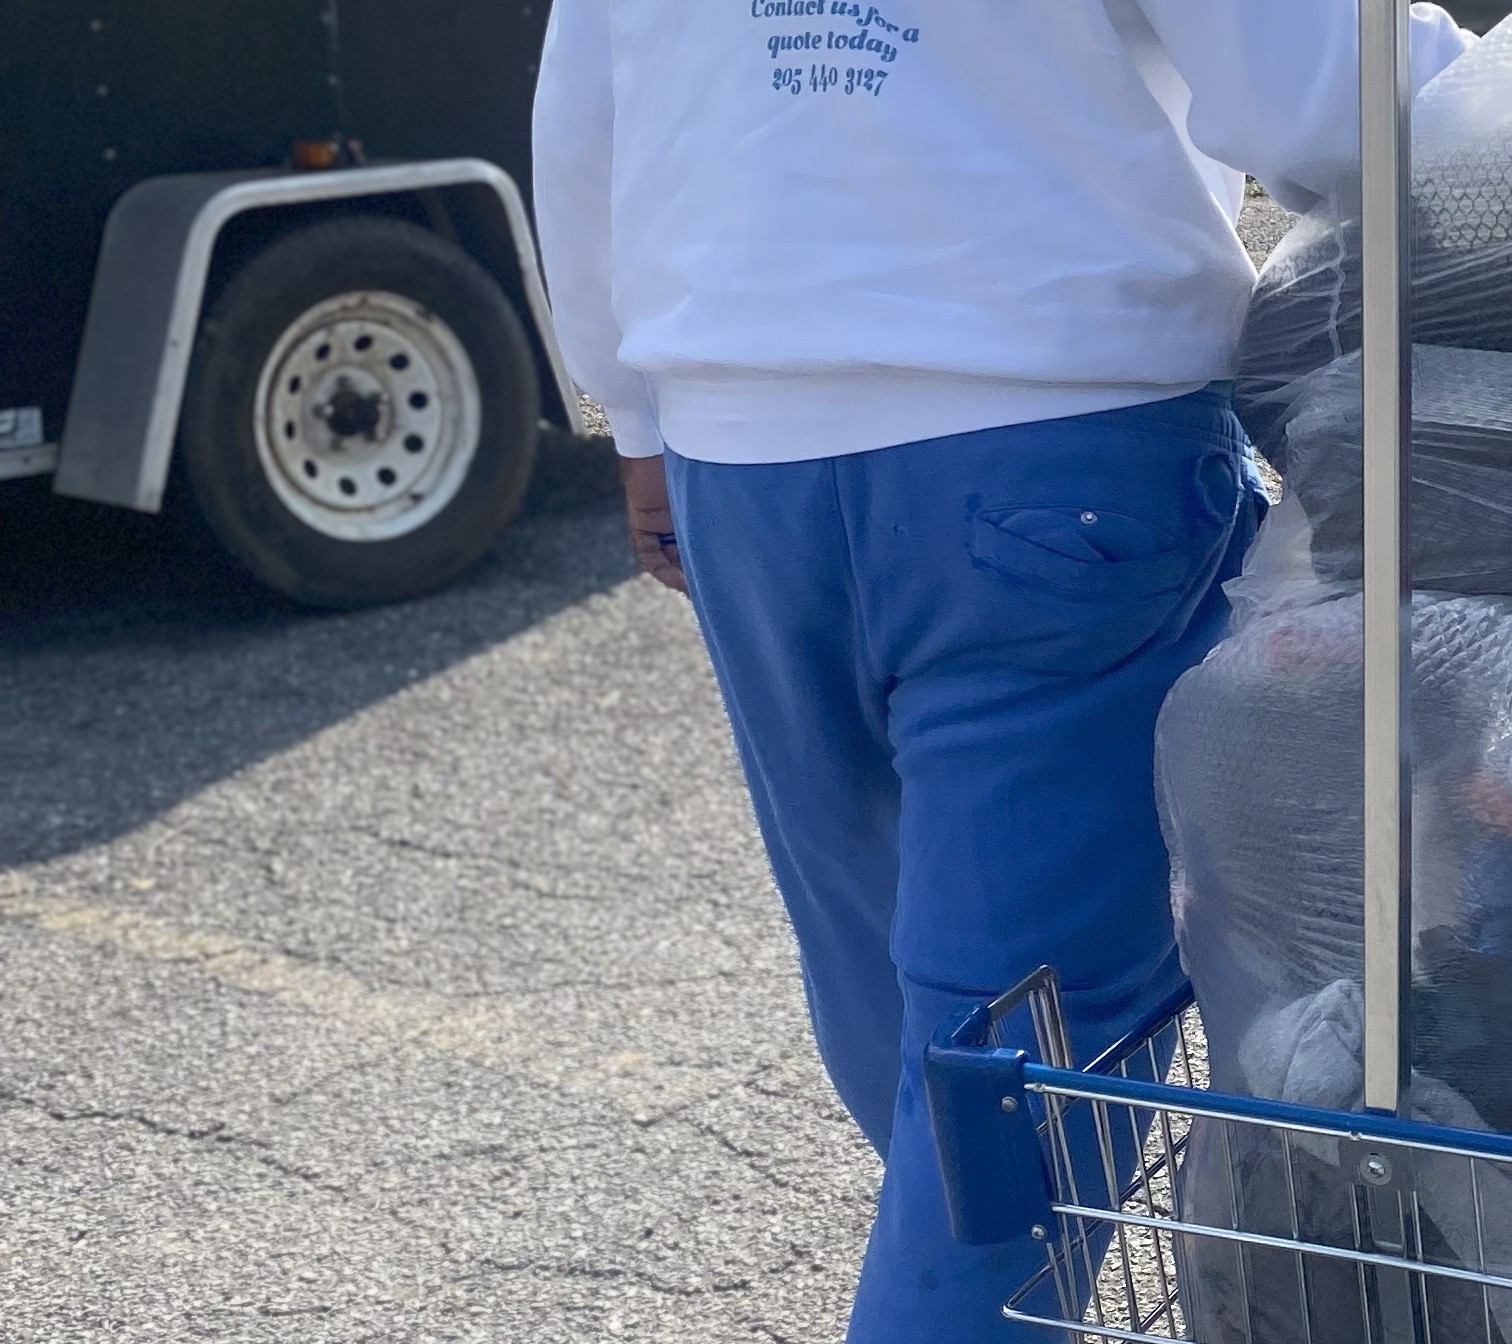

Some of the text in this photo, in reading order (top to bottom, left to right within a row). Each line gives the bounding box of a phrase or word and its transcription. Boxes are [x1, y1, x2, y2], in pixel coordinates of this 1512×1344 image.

[830, 0, 860, 17] us
[855, 6, 899, 33] for
[902, 27, 920, 43] a
[767, 28, 898, 63] quote today
[771, 63, 889, 97] 205 440 3127
